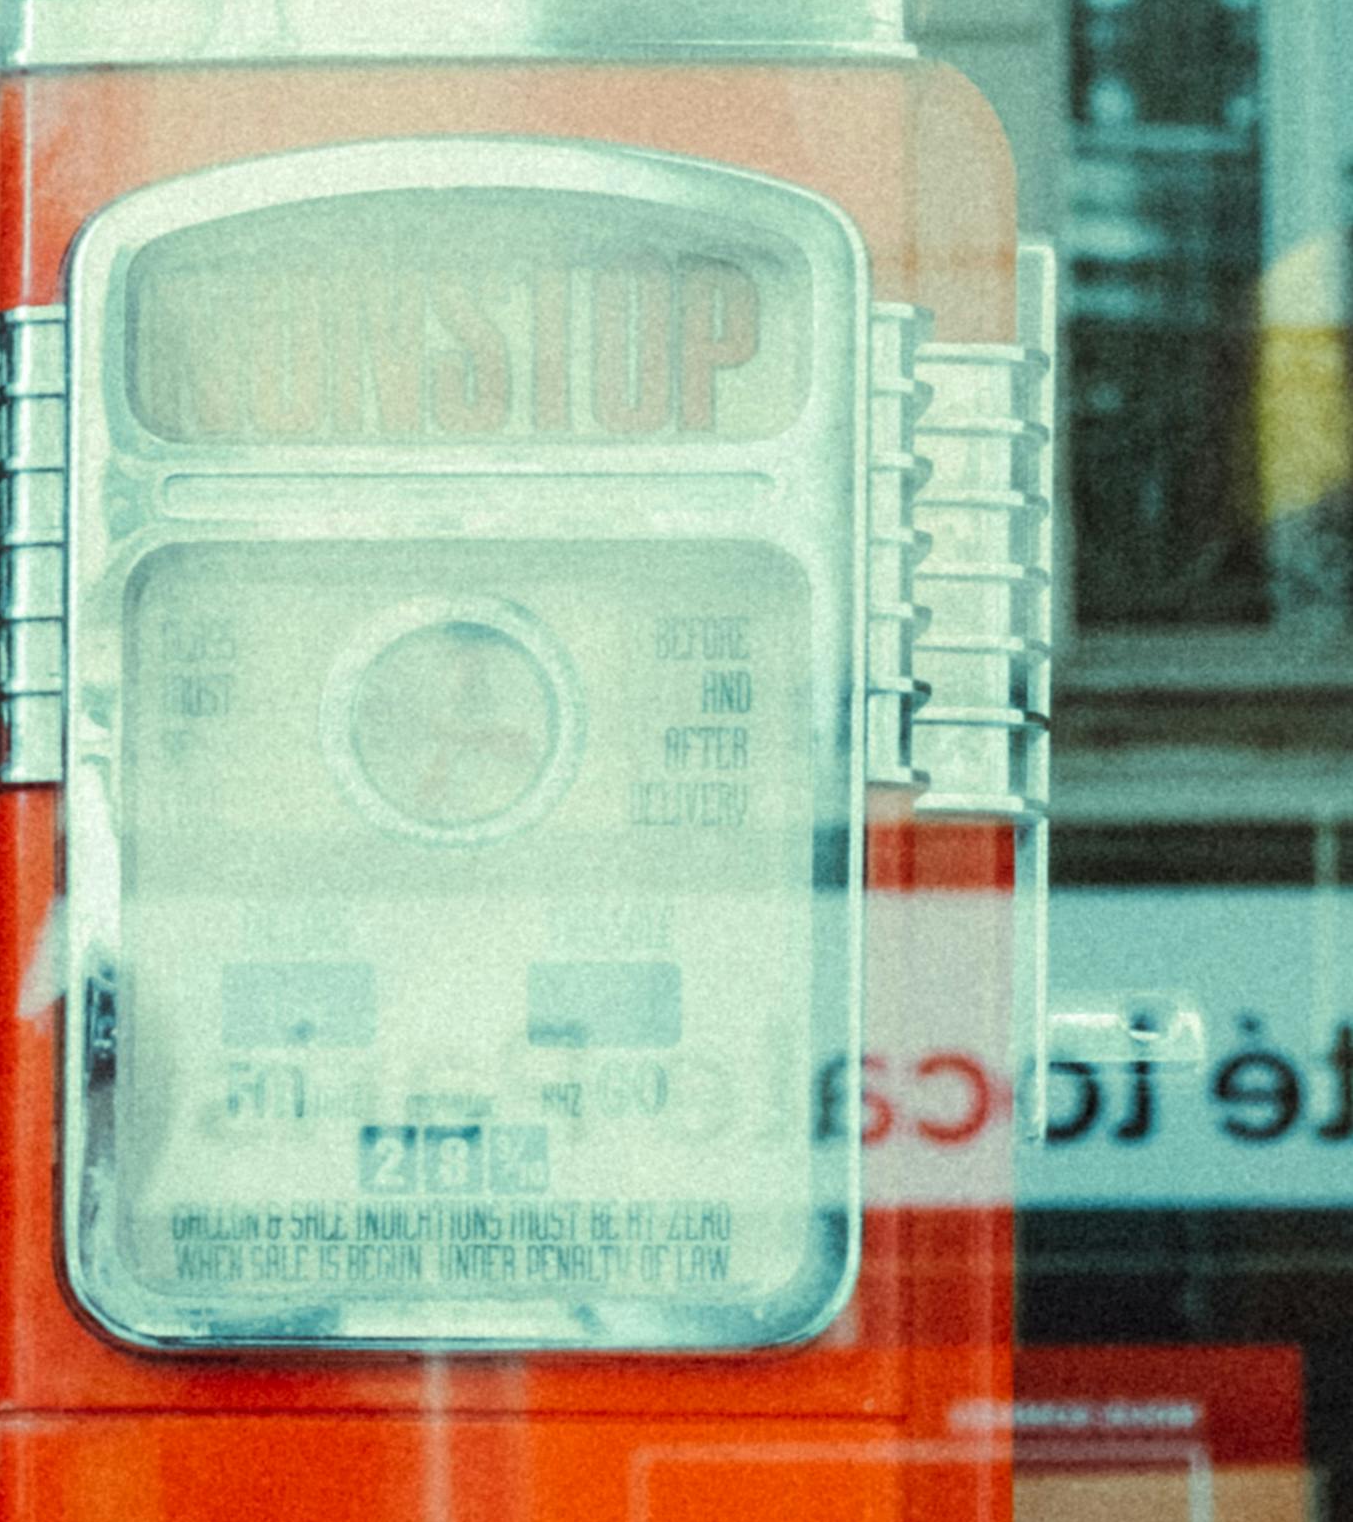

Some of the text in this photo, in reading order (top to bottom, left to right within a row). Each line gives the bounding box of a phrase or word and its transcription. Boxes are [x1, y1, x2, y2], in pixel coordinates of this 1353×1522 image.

[701, 670, 752, 714] AND
[664, 726, 749, 770] AFTER
[290, 1199, 348, 1241] SALE
[510, 1199, 579, 1241] MUST
[675, 1244, 732, 1280] LAW
